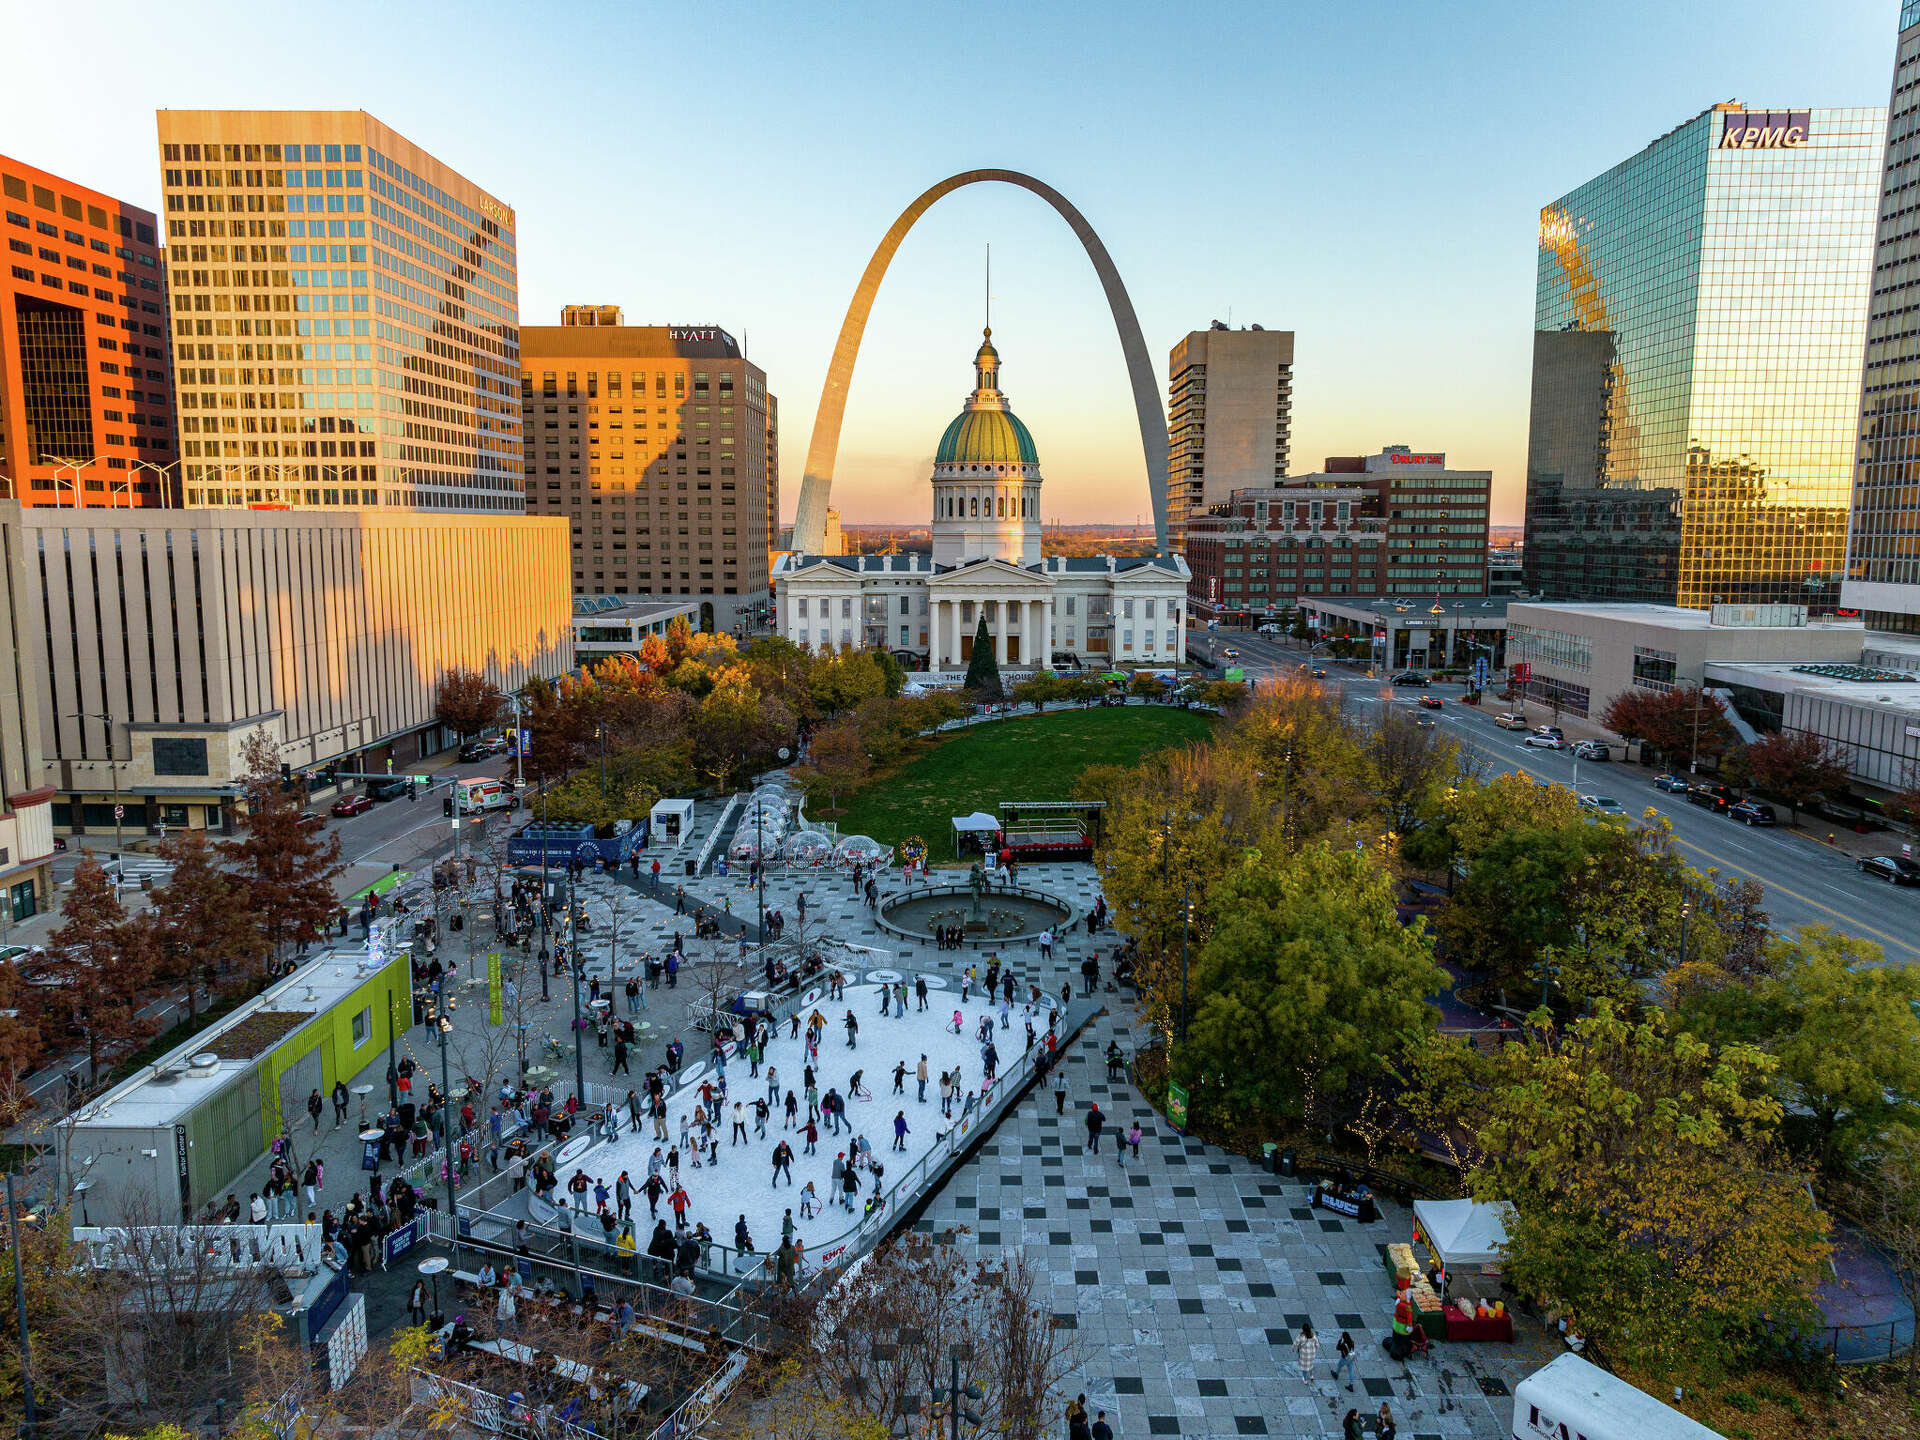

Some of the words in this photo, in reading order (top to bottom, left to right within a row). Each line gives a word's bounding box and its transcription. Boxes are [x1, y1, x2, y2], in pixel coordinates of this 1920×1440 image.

[1720, 126, 1804, 149] KPMG
[480, 194, 509, 225] LARSON
[669, 330, 716, 342] HYATT
[1391, 453, 1427, 465] DRURY
[1321, 1193, 1359, 1214] BLUES
